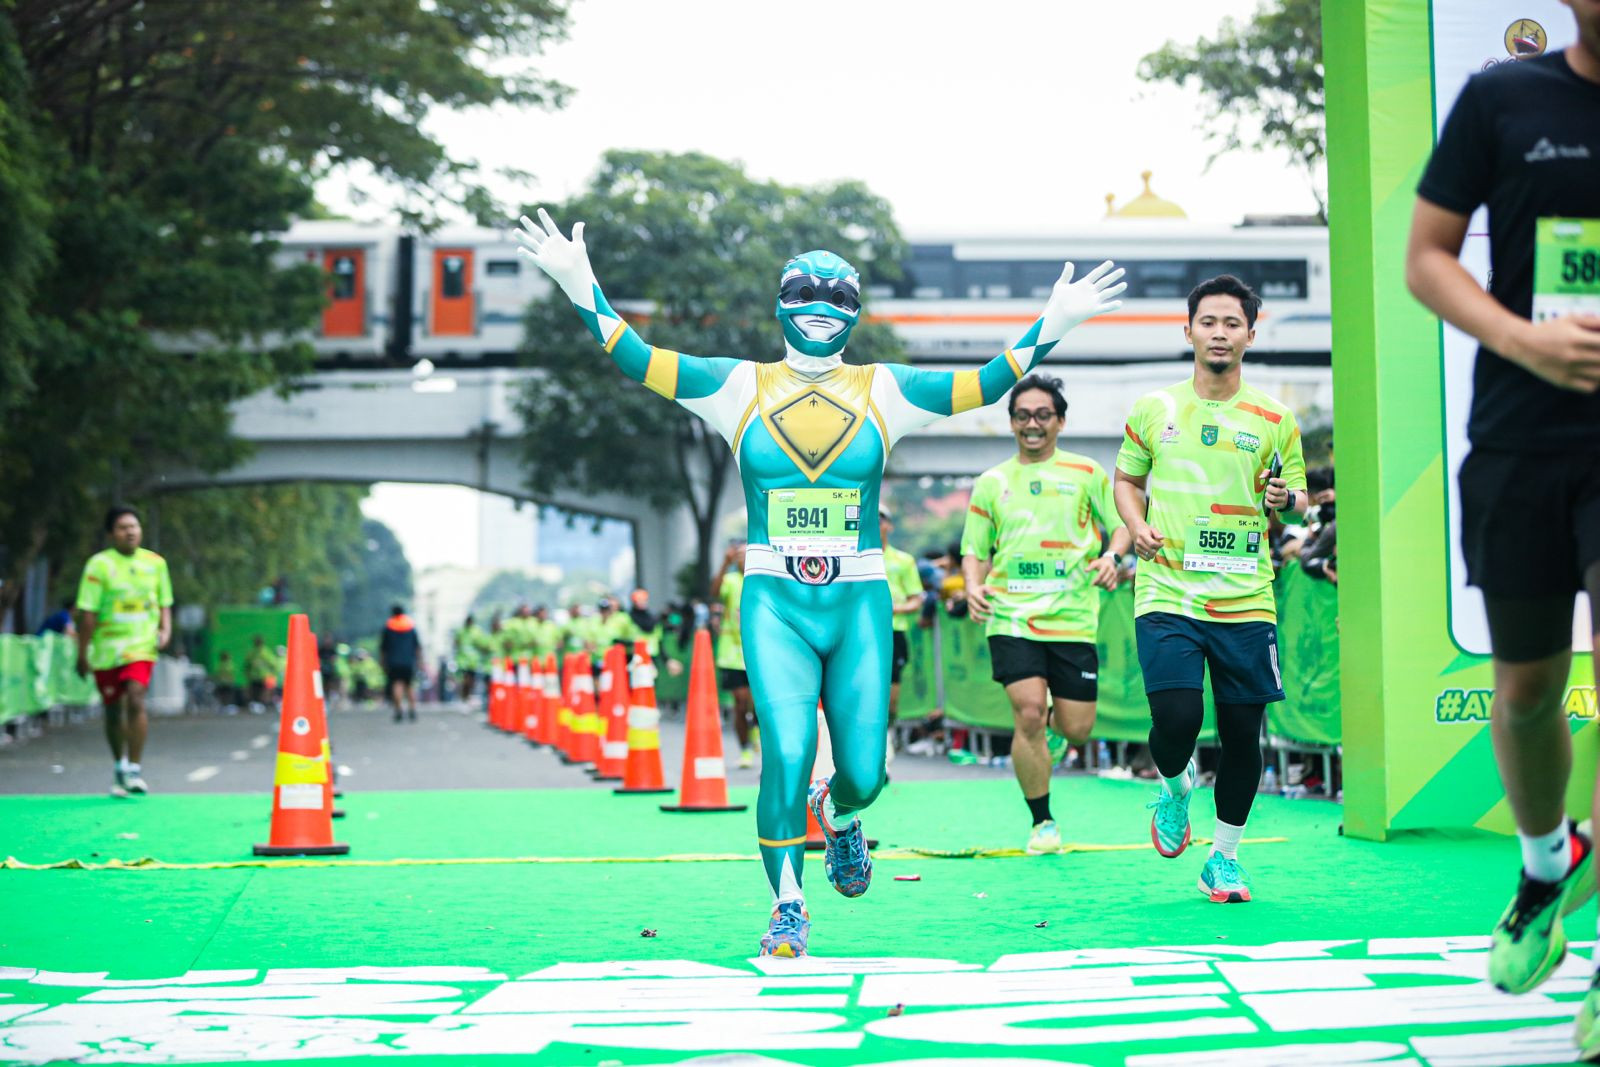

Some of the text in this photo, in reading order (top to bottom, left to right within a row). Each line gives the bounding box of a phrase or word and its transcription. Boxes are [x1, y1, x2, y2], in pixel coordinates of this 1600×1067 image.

[1561, 249, 1600, 284] 58
[786, 507, 828, 528] 5941
[1199, 530, 1236, 550] 5552
[1018, 562, 1044, 576] 5851
